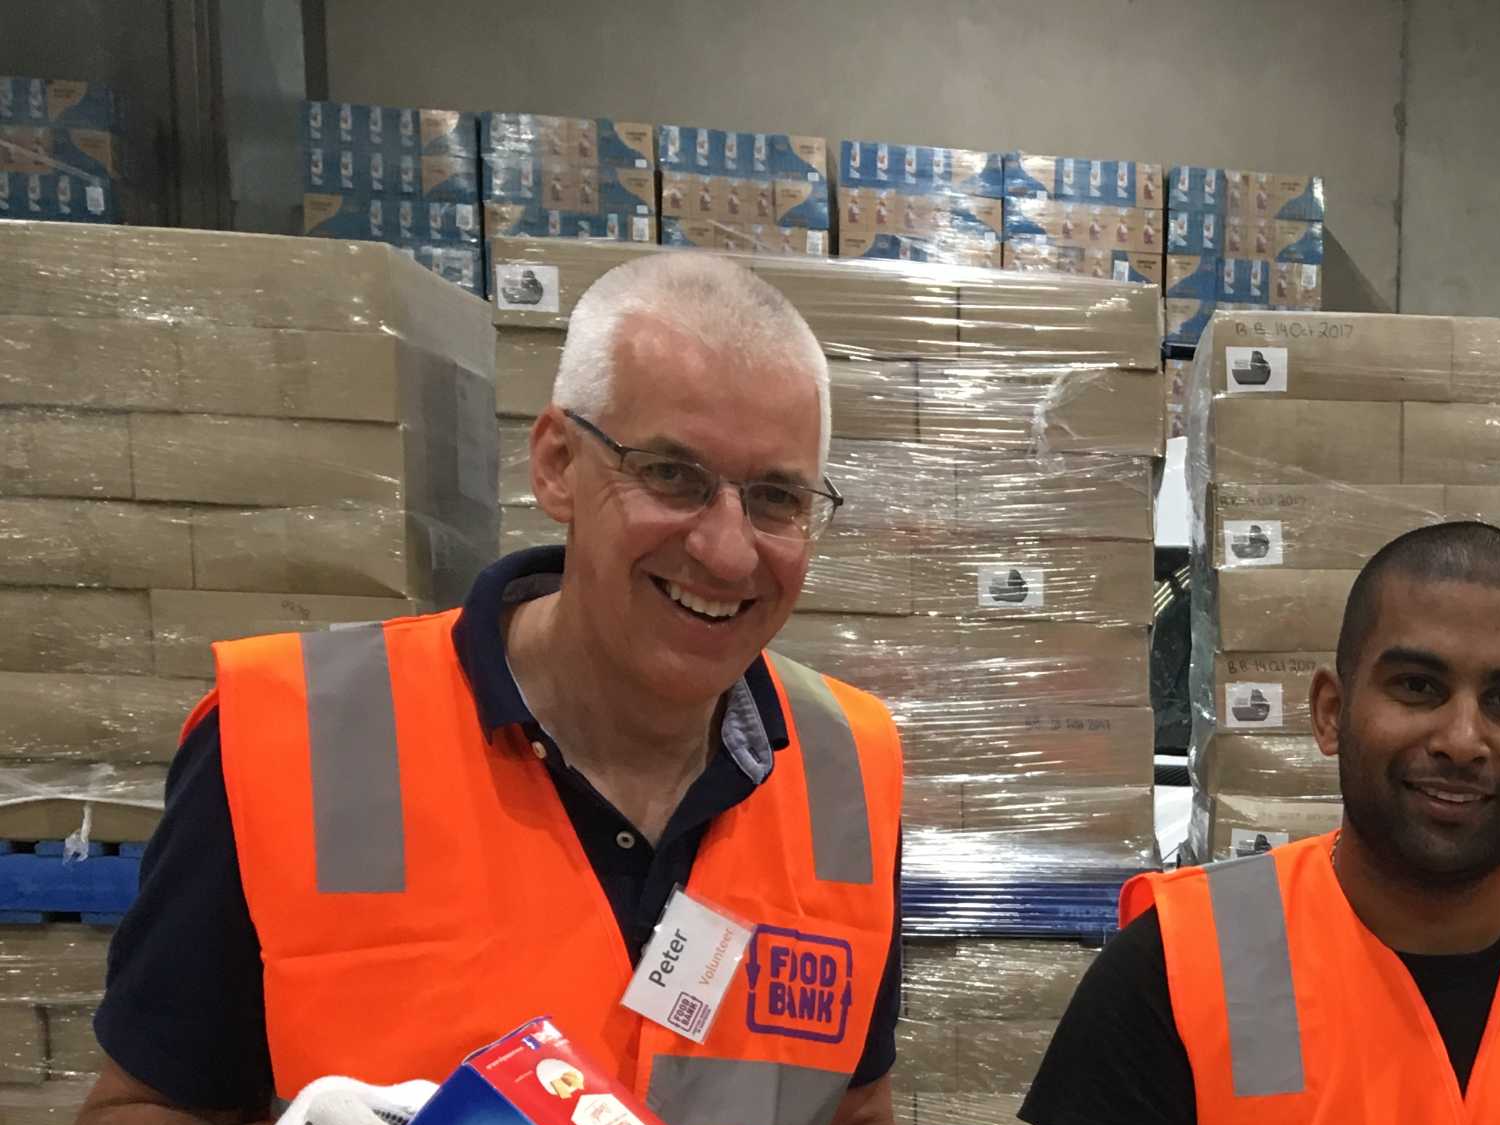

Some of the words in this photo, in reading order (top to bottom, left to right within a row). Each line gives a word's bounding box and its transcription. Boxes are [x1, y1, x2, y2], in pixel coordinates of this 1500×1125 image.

[1319, 321, 1354, 338] 2017
[647, 927, 688, 988] Peter
[697, 926, 734, 985] Volunteer
[672, 997, 690, 1021] FOOD
[680, 1000, 698, 1026] BANK
